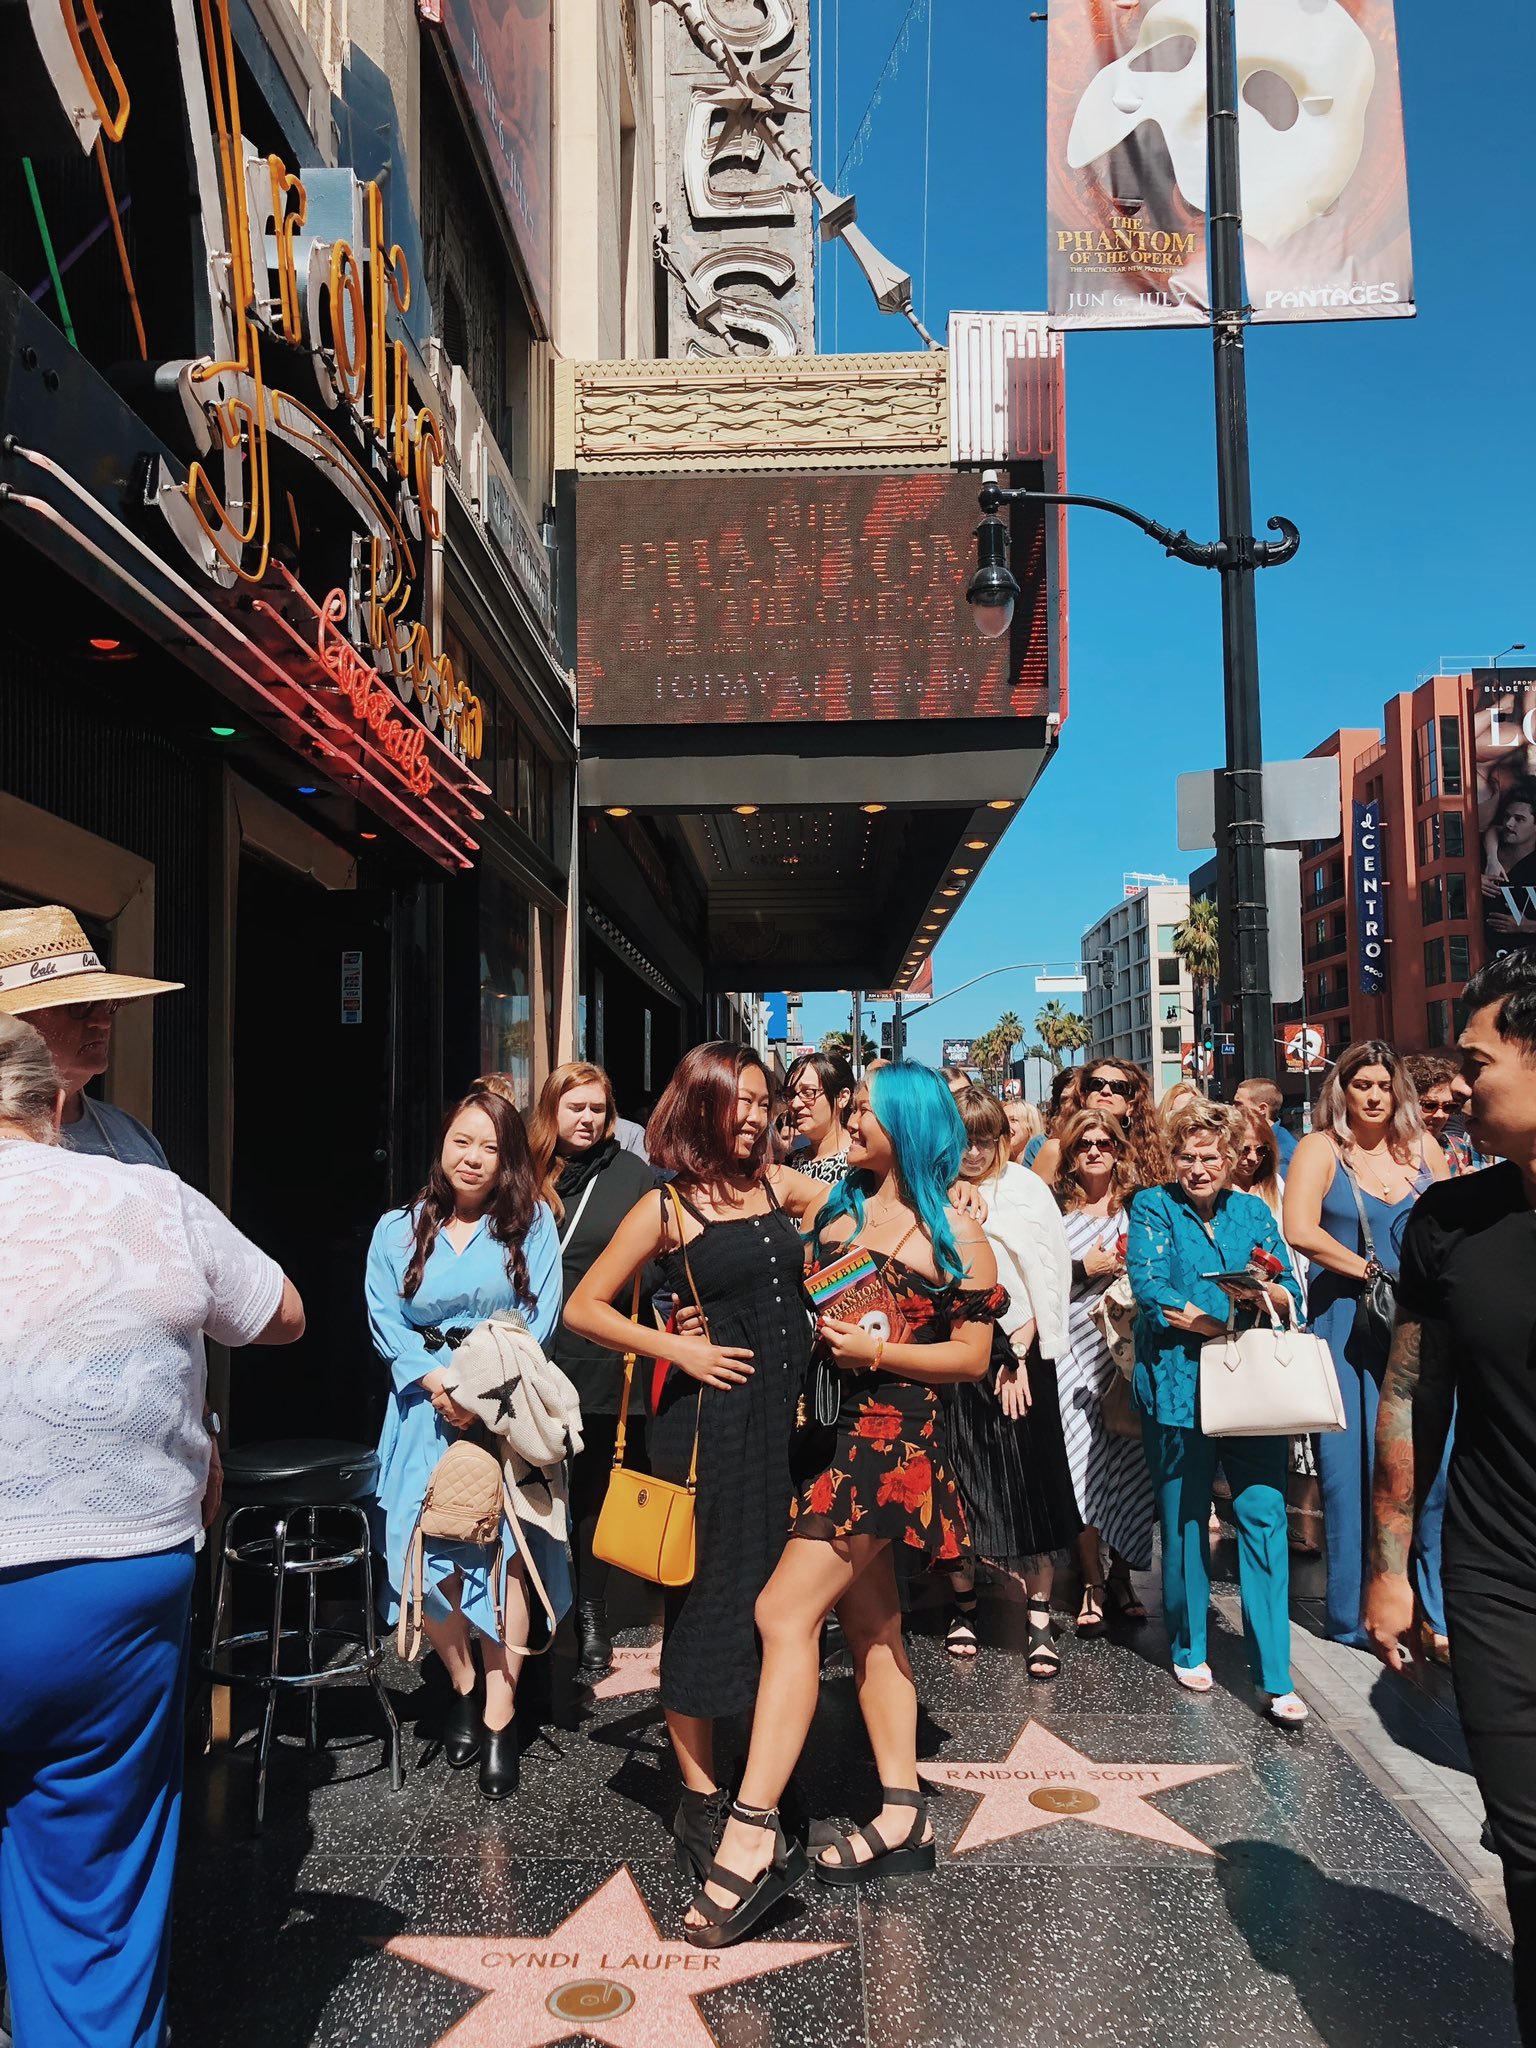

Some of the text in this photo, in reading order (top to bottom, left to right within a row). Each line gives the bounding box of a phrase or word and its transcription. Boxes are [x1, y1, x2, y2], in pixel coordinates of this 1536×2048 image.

[1109, 217, 1143, 230] THE
[1056, 229, 1196, 253] PHANTOM
[1069, 250, 1184, 266] OF THE OPERA
[1144, 266, 1184, 274] PRODUCTION
[1068, 293, 1105, 311] JUN
[1112, 294, 1122, 307] 6
[1139, 292, 1172, 310] JUL
[1178, 291, 1187, 307] 7
[1265, 282, 1399, 309] PANTAGES
[1484, 685, 1518, 693] BLADE
[1361, 834, 1381, 958] CENTRO
[811, 1257, 870, 1294] PLAYBILL
[824, 1279, 883, 1318] PHANTOM
[842, 1286, 858, 1299] THE
[844, 1304, 858, 1316] THE
[857, 1291, 881, 1307] OPERA
[946, 1770, 1161, 1783] RANDOLPH SCOTT
[480, 1952, 721, 1971] CYNDI LAUPER
